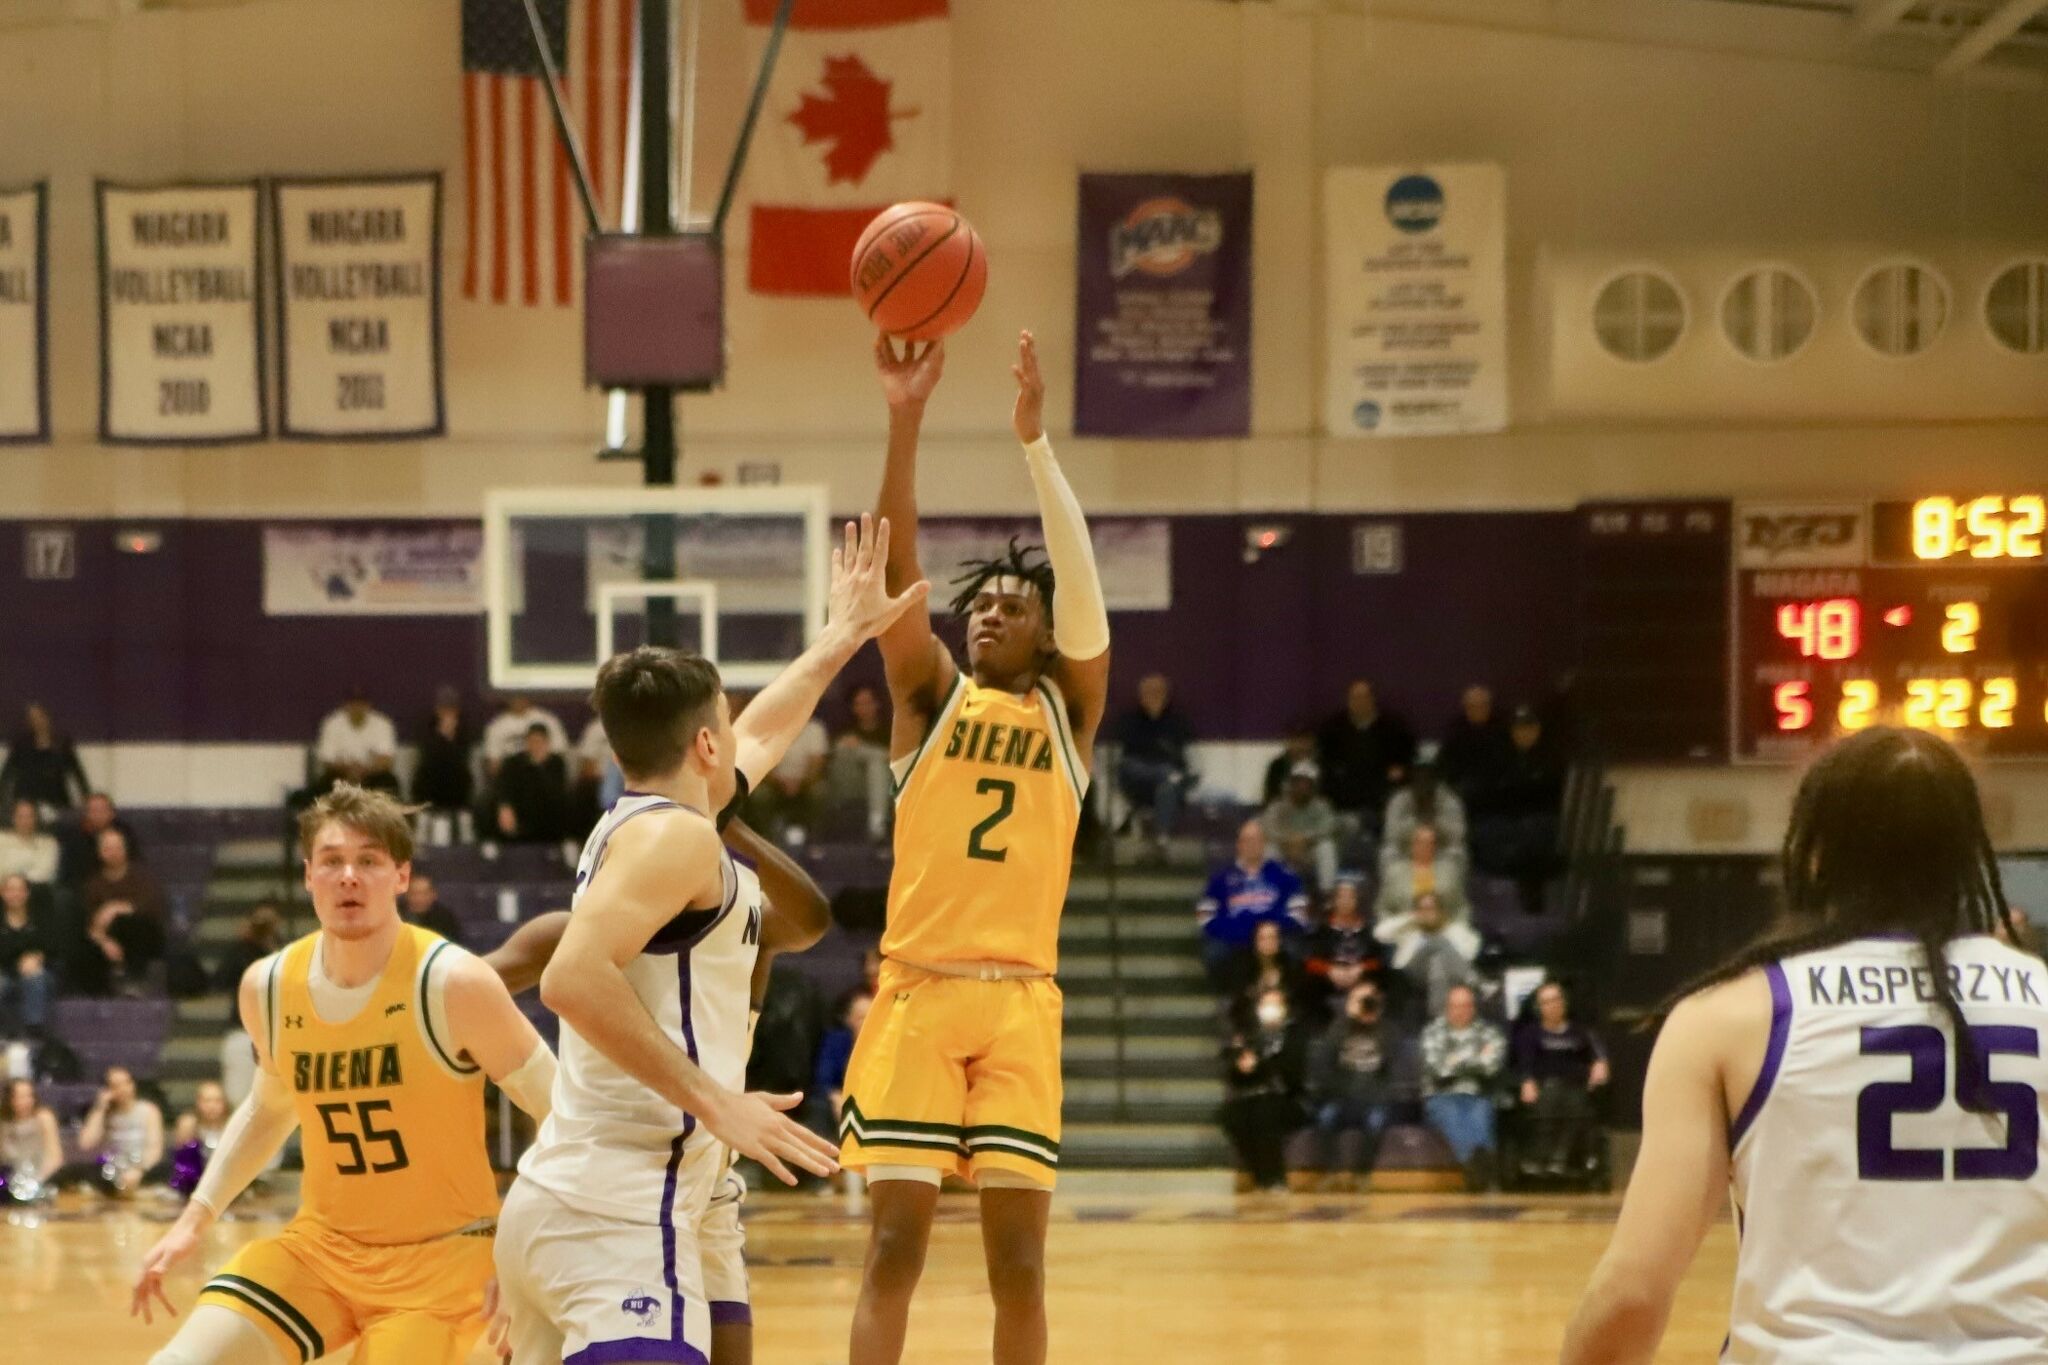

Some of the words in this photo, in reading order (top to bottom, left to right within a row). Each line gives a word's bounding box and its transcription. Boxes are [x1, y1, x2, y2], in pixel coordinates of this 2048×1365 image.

[132, 211, 229, 246] NIAGARA
[308, 208, 406, 245] NIAGARA
[112, 266, 250, 303] VOLLEYBALL
[291, 262, 424, 299] VOLLEYBALL
[152, 322, 213, 358] NCAA
[328, 317, 390, 354] NCAA
[1911, 495, 2046, 560] 8:52
[1777, 599, 1860, 659] 48
[1942, 602, 1980, 653] 2
[1838, 679, 1880, 730] 2
[1904, 678, 1972, 728] 22
[1979, 677, 2017, 728] 2
[943, 720, 1053, 773] SIENA
[967, 778, 1015, 863] 2
[1808, 963, 2041, 1005] KASPERZYK
[291, 1043, 403, 1093] SIENA
[1857, 1024, 2039, 1180] 25
[315, 1099, 409, 1175] 55
